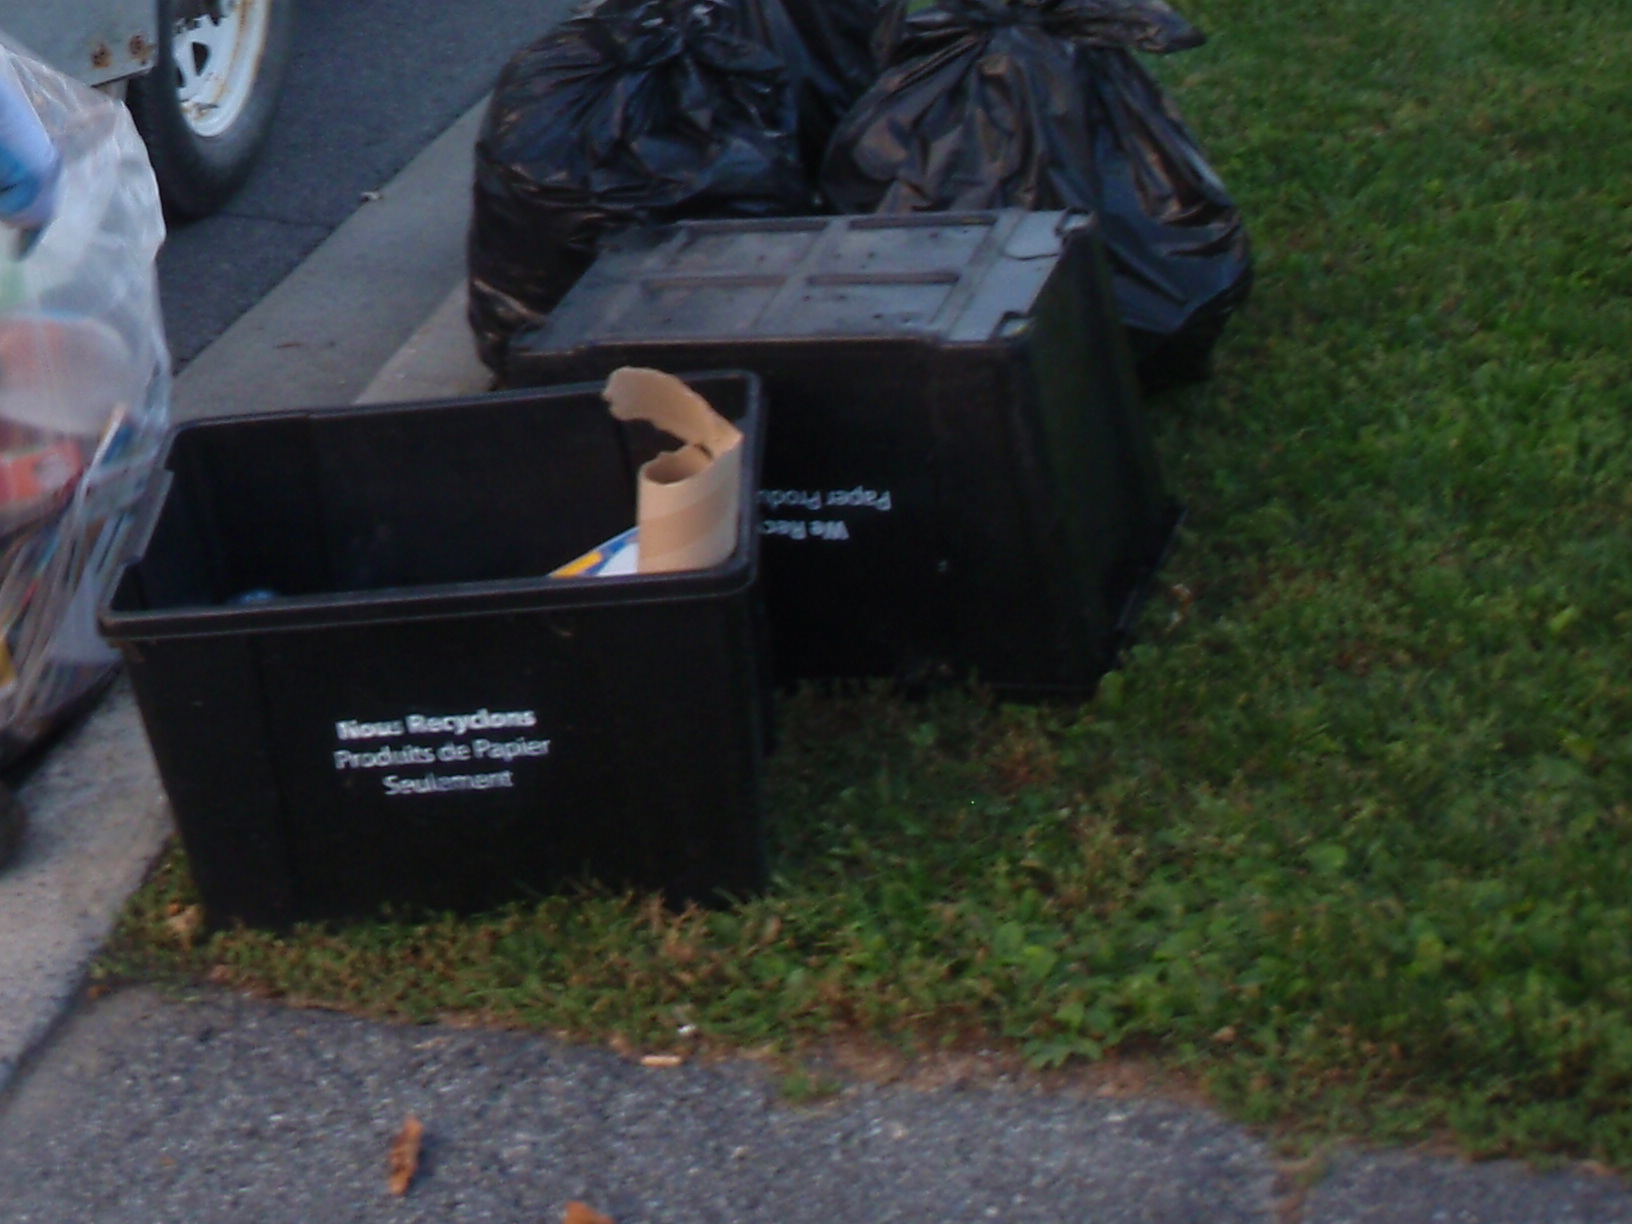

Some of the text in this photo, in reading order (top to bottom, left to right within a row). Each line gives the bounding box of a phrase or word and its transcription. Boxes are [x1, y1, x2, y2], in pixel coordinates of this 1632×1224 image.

[827, 484, 892, 512] Paper
[335, 719, 404, 740] Nous
[333, 737, 551, 770] Produits de Papier
[382, 770, 514, 796] Seulement
